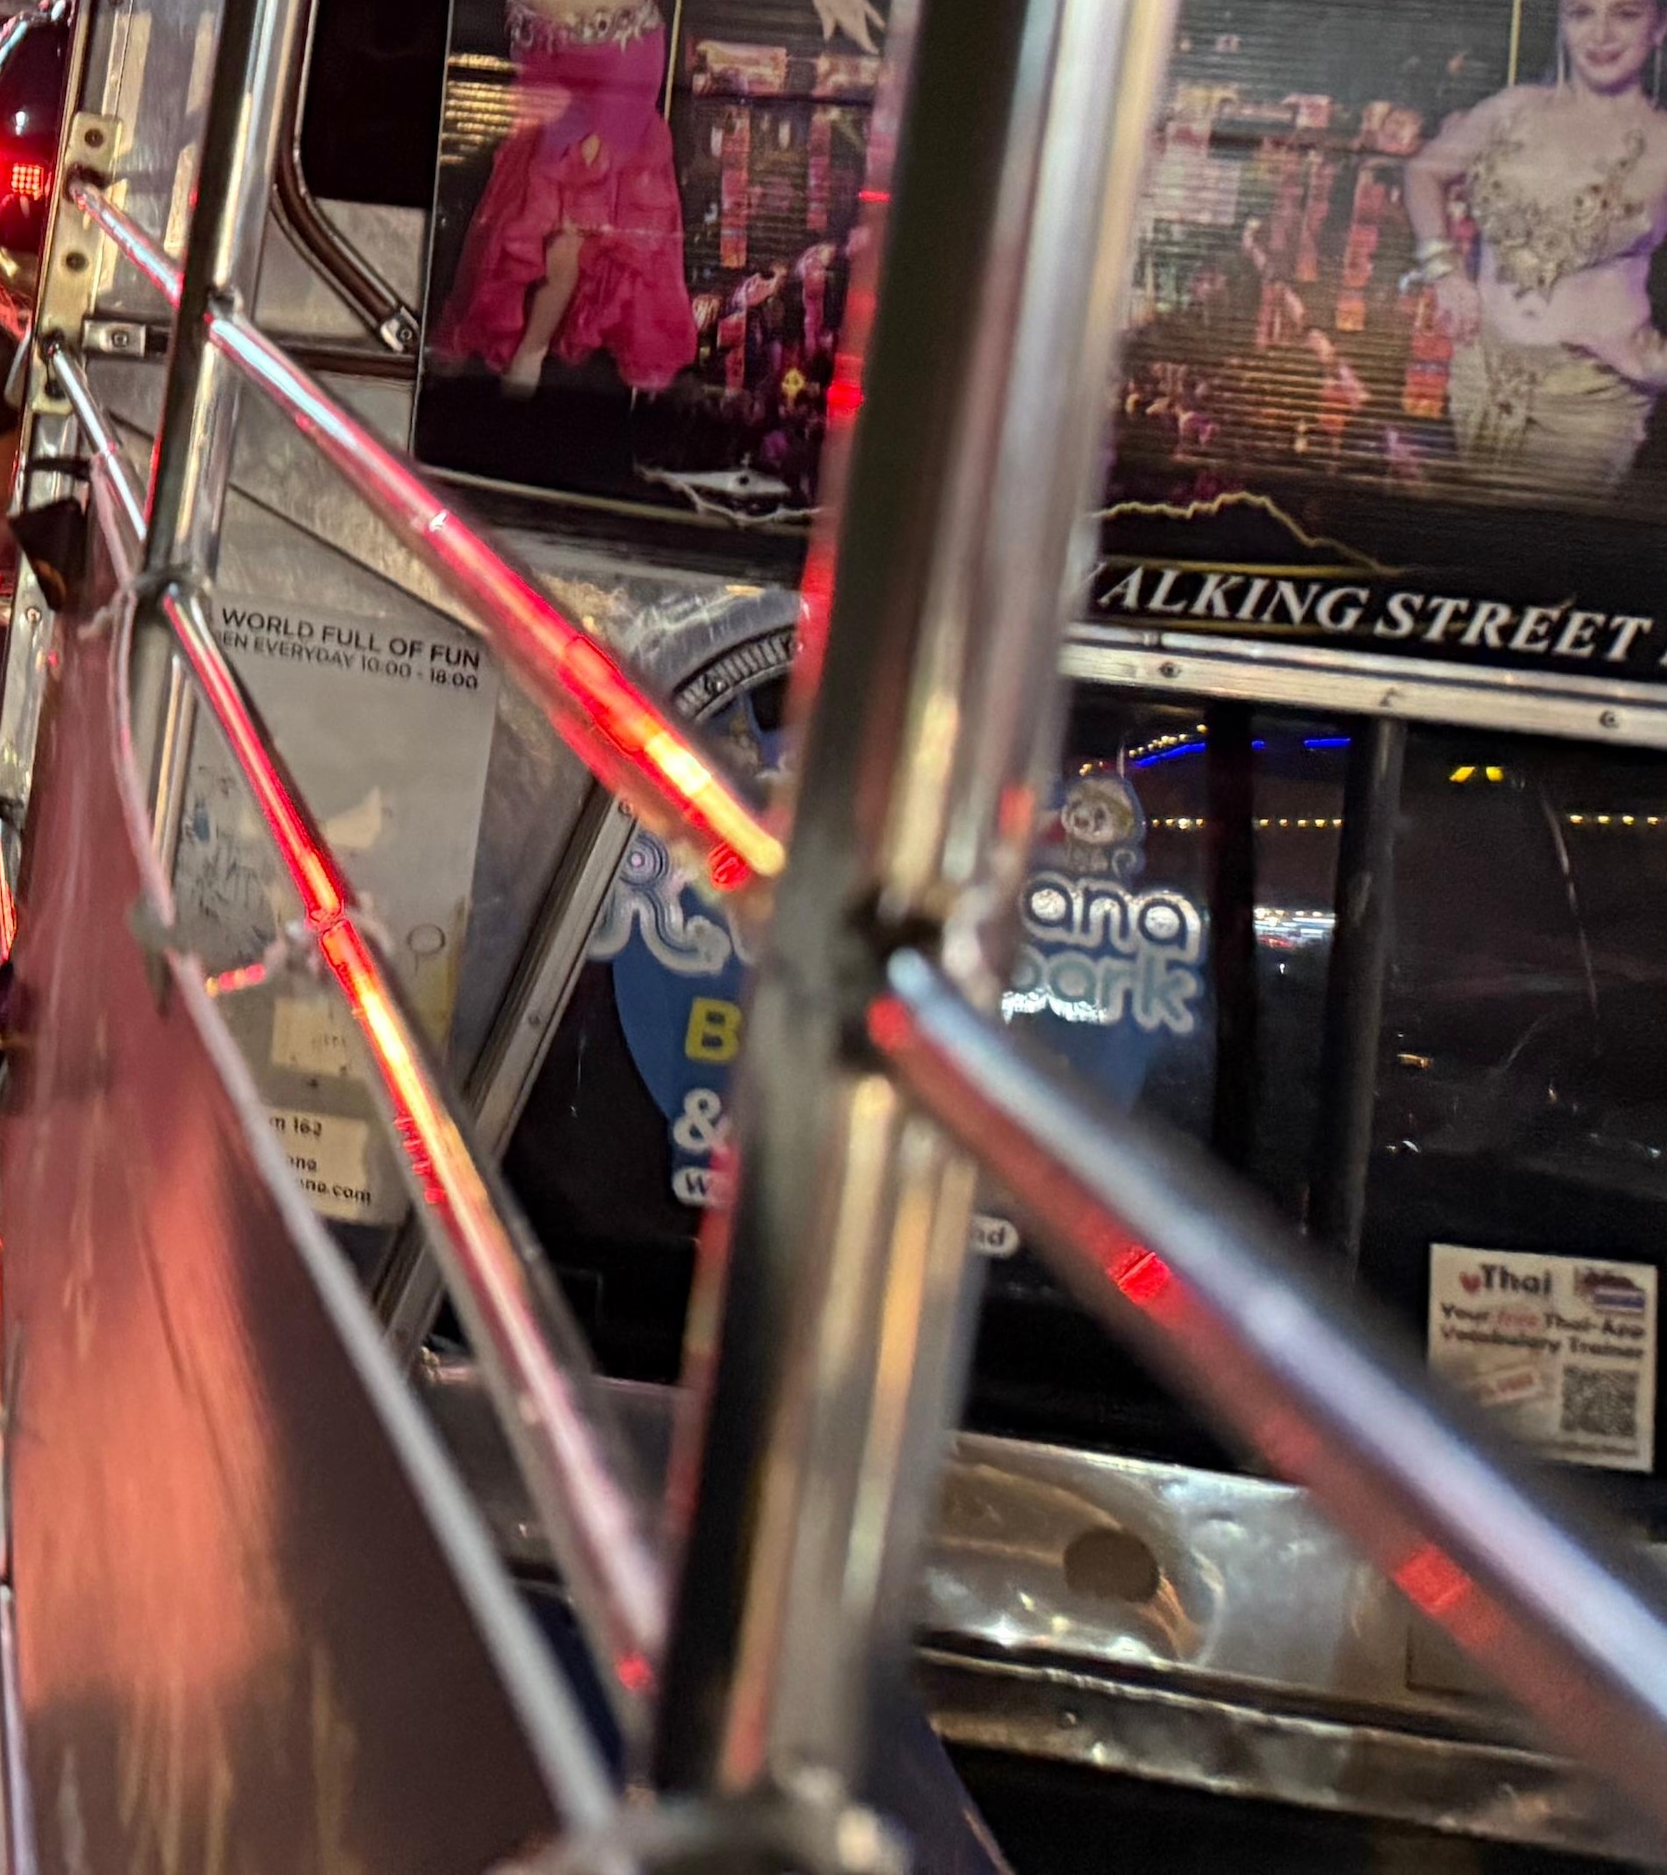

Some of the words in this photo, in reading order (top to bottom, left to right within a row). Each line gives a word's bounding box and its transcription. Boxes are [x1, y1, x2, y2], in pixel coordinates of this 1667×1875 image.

[1085, 561, 1370, 633] ALKING
[1373, 591, 1653, 662] STREET
[222, 608, 314, 639] WORLD
[322, 624, 381, 652] FULL
[389, 636, 423, 658] OF
[430, 644, 480, 671] FUN
[254, 636, 354, 669] EVERYDAY
[1480, 1263, 1553, 1296] Thai
